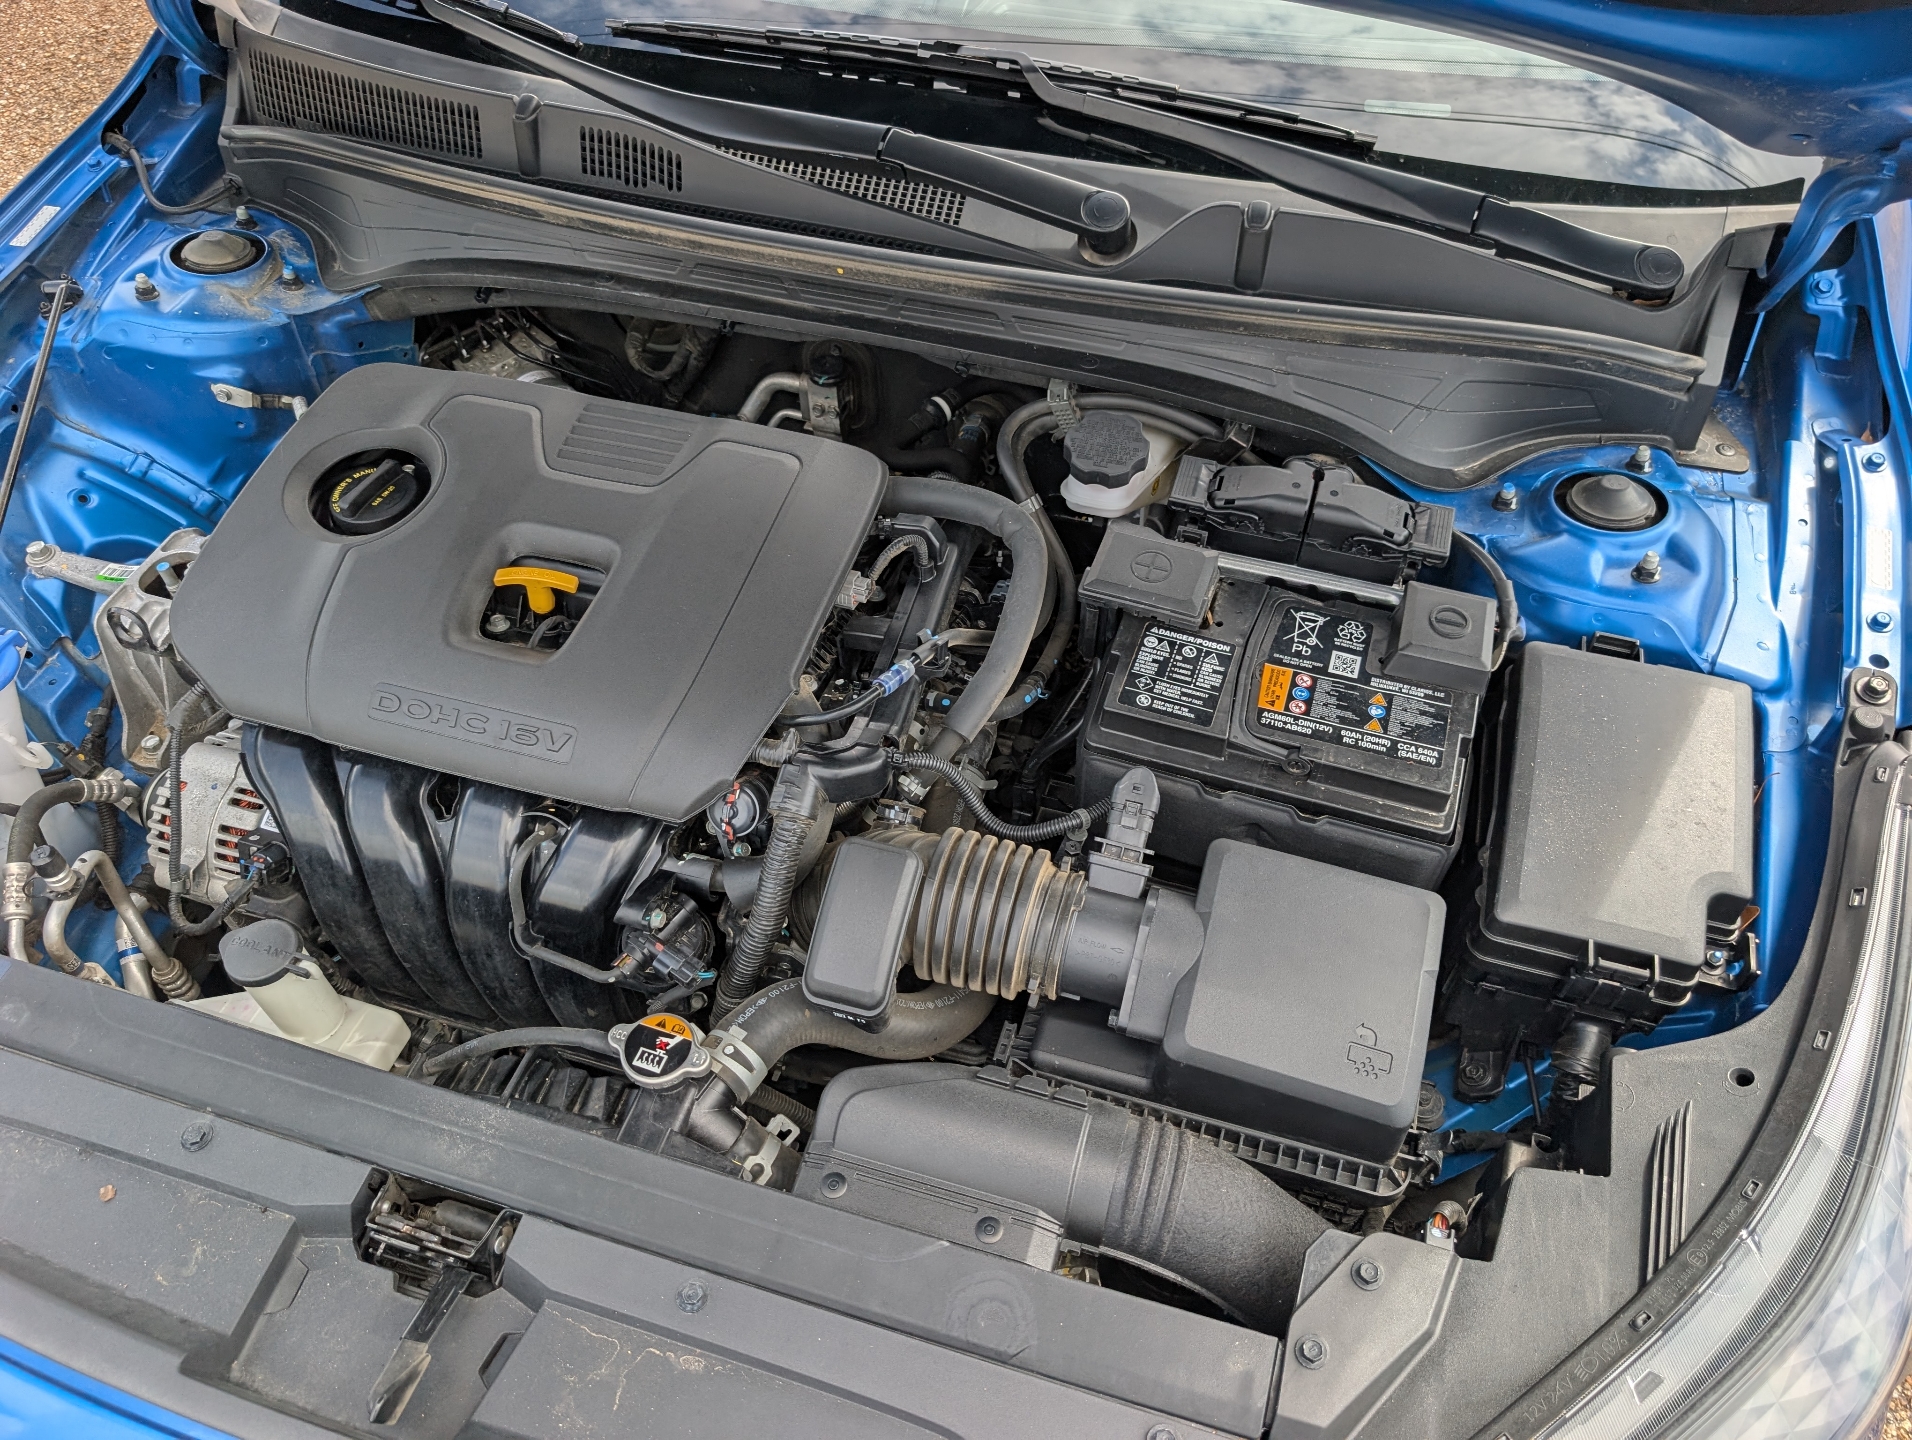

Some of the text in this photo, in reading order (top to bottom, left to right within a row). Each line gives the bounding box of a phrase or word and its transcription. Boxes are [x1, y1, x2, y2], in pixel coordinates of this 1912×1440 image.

[332, 478, 352, 501] OWNER'S
[1158, 628, 1230, 652] DANGER/POISON
[1291, 642, 1312, 656] Pb
[371, 690, 572, 752] DOHC 16V
[1262, 712, 1332, 733] AGM60L-DIN(12V)
[1341, 730, 1391, 747] 60Ah (20HR)
[1358, 740, 1386, 752] 100min
[1398, 743, 1439, 758] CCA 640A
[1398, 750, 1436, 765] (SAE/EN)
[231, 936, 292, 958] COOLANT
[610, 1028, 627, 1040] HCC
[1726, 1200, 1748, 1223] MOBIS
[1523, 1398, 1547, 1422] 12V
